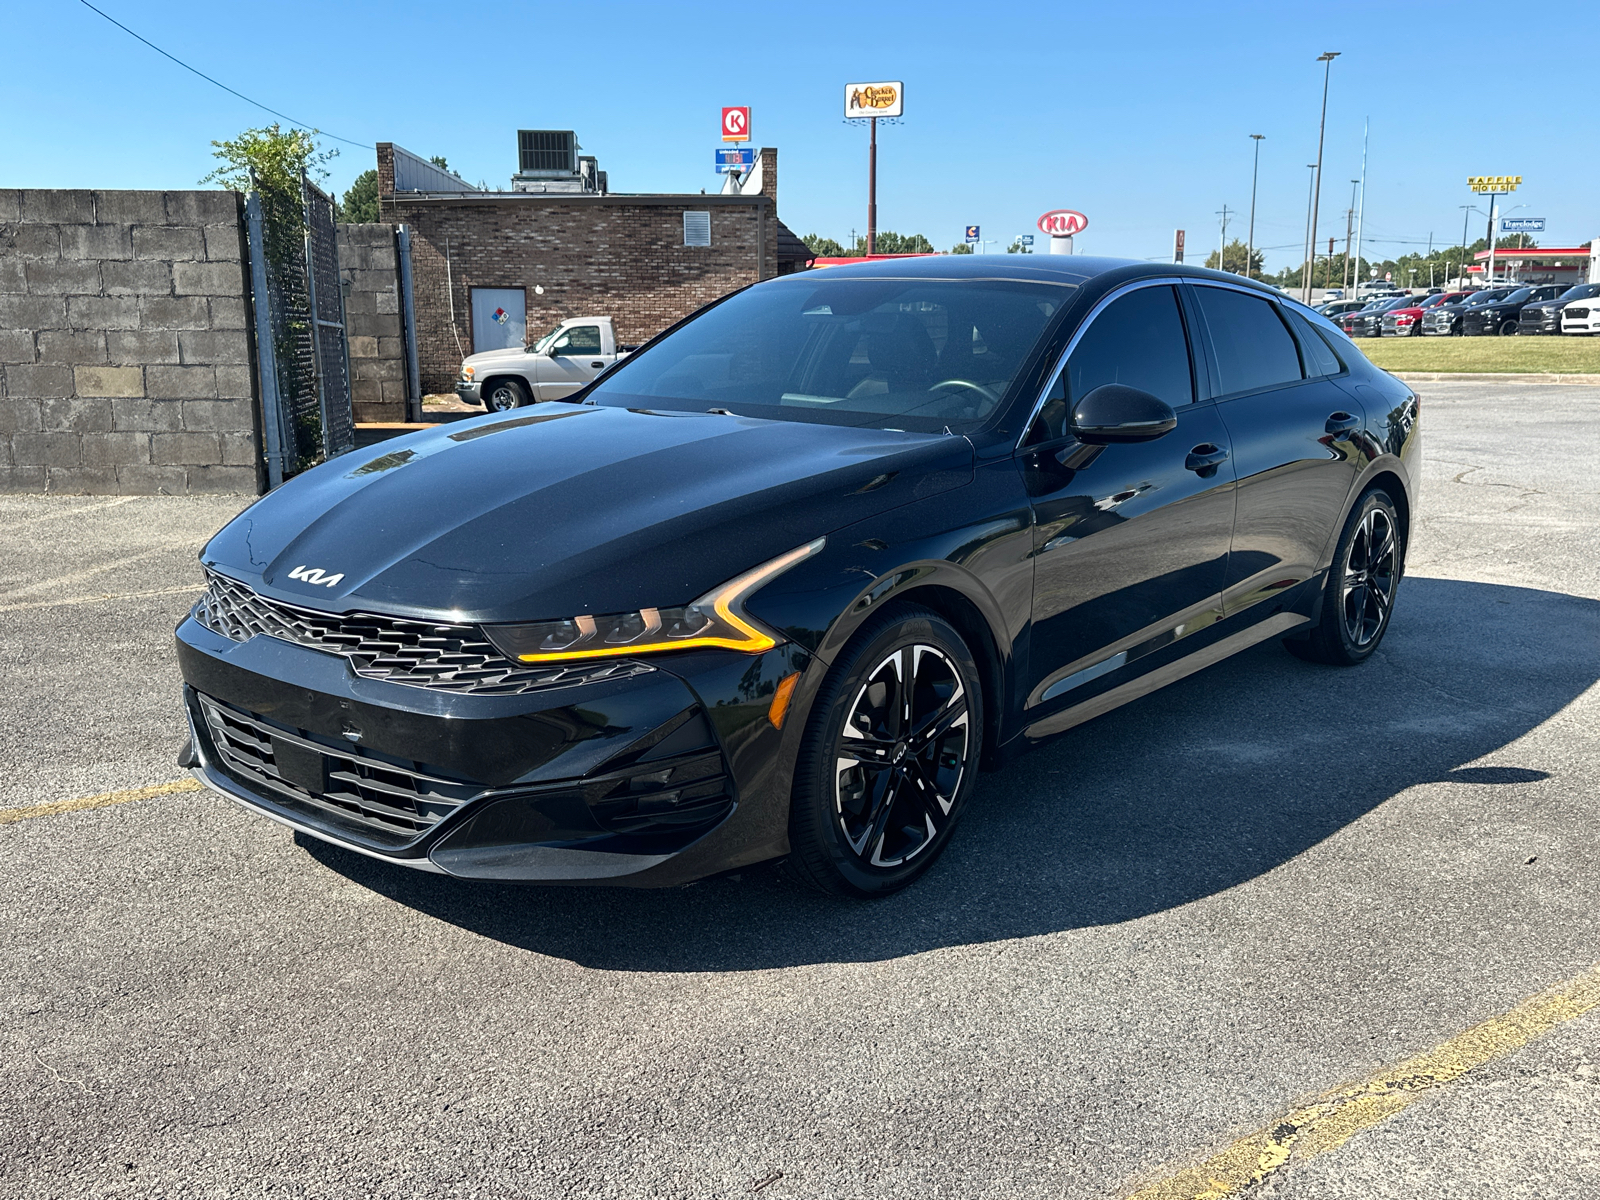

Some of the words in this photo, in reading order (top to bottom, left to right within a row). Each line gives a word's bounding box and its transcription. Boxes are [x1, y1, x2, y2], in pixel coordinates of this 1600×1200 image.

[731, 114, 743, 129] K
[1046, 216, 1079, 231] KIA
[1504, 220, 1543, 228] Travelodge
[287, 564, 345, 588] KIA
